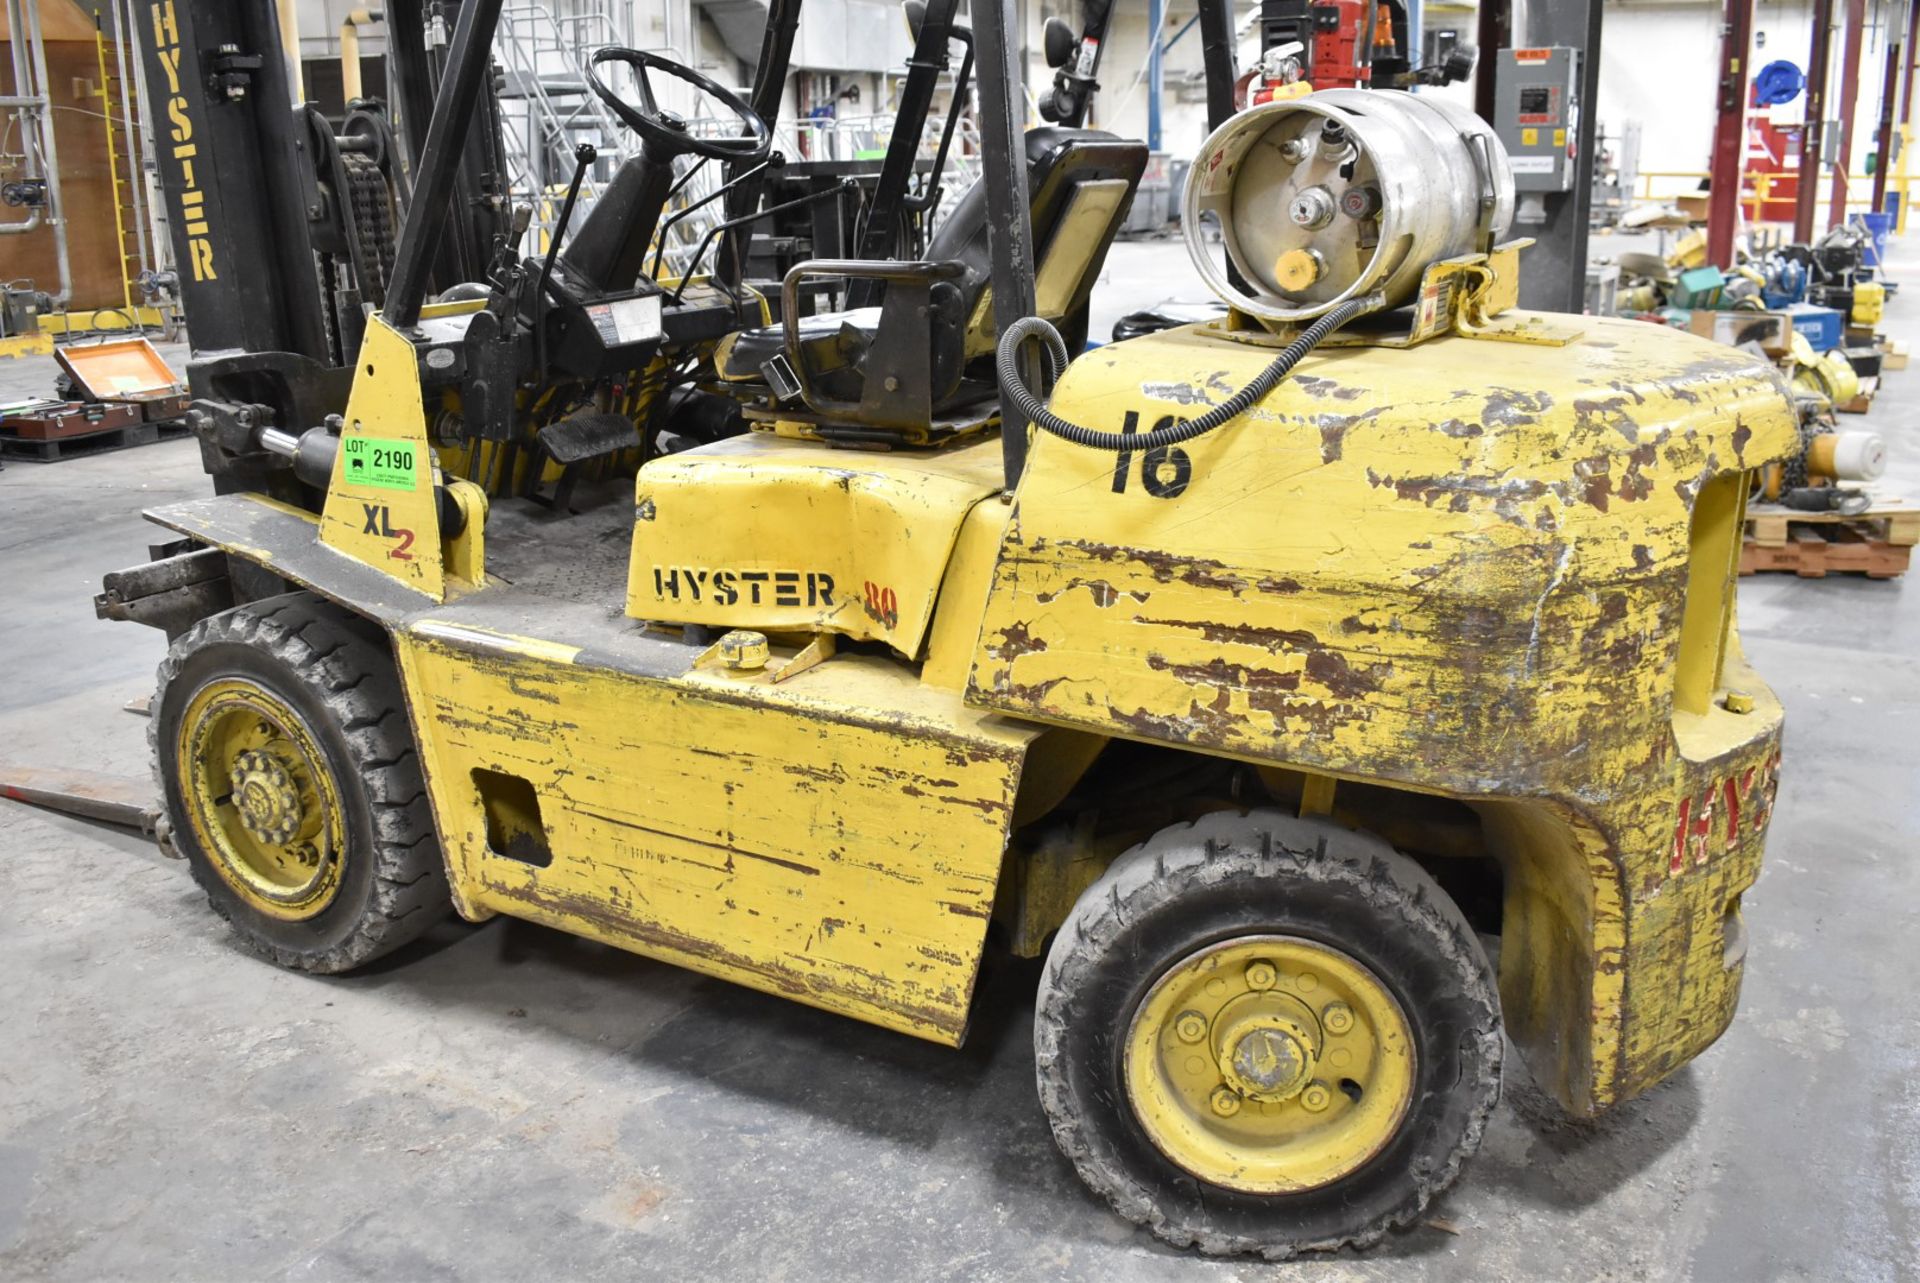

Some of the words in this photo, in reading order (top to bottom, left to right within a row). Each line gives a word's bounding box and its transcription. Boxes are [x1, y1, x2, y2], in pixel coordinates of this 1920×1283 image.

[152, 0, 217, 281] HYSTER
[373, 449, 412, 470] 2190
[1111, 411, 1192, 498] 16
[362, 503, 399, 538] XL
[391, 529, 415, 560] 2
[654, 569, 835, 606] HYSTER
